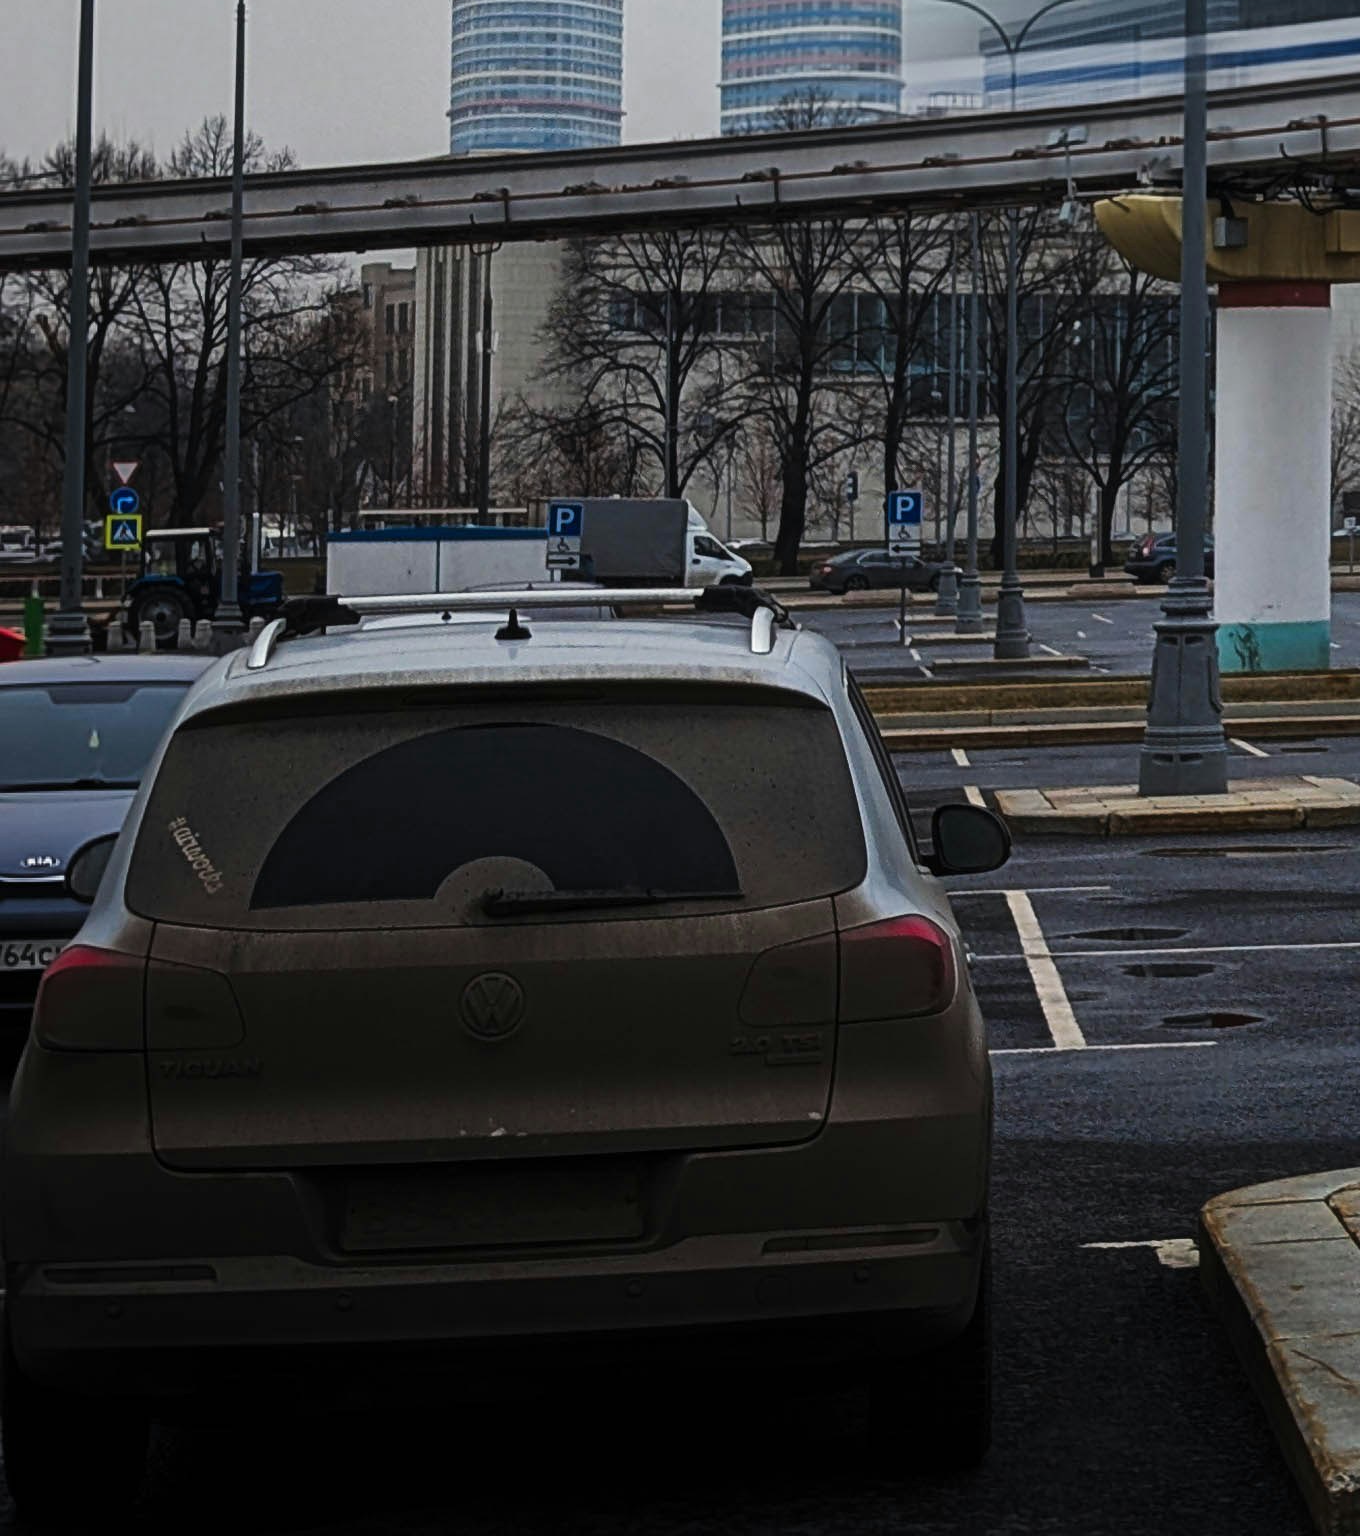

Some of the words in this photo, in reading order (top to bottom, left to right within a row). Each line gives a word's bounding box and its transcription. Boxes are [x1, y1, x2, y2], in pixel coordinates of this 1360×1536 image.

[556, 508, 575, 532] P
[896, 496, 914, 520] P
[158, 1057, 263, 1080] TIGUAN
